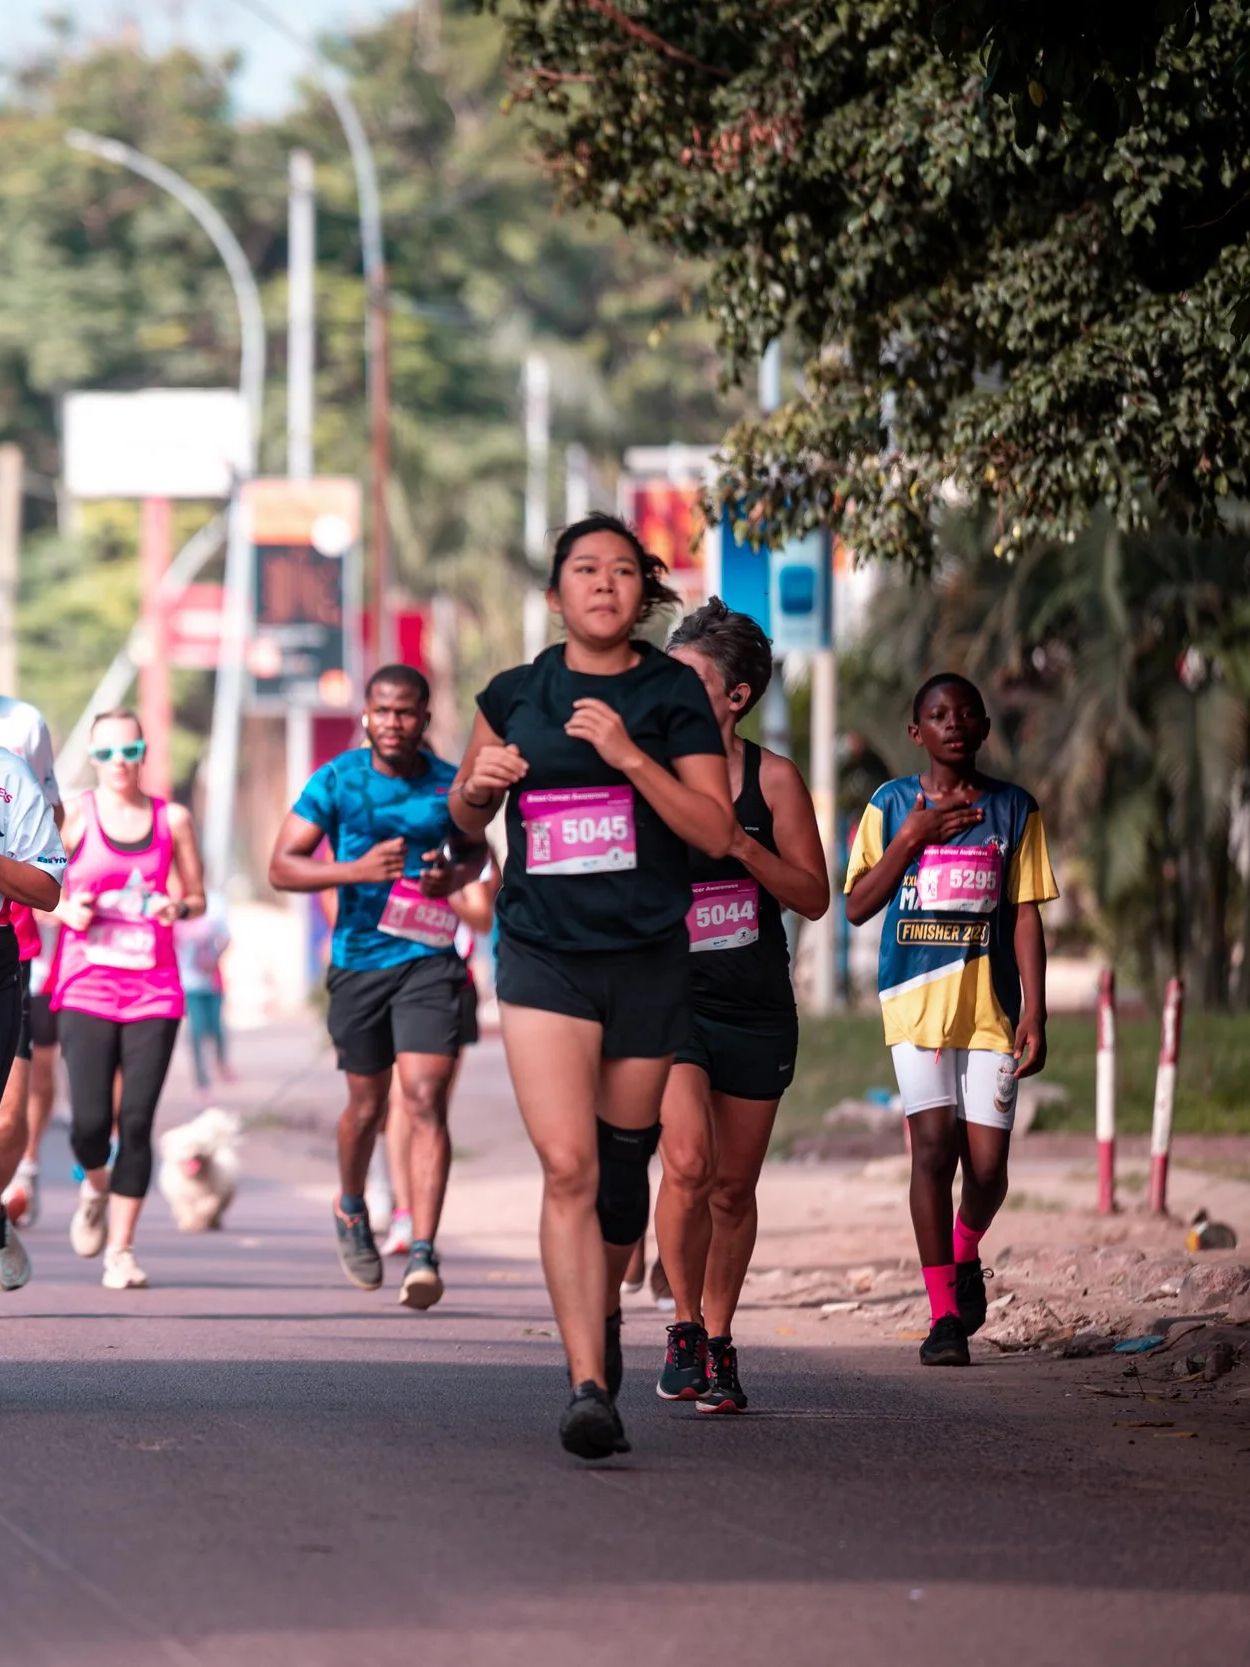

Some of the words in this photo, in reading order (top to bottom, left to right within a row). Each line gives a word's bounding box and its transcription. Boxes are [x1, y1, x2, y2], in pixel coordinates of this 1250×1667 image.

[561, 815, 628, 845] 5045
[950, 868, 997, 890] 5295
[696, 900, 755, 928] 5044
[902, 924, 961, 940] FINISHER
